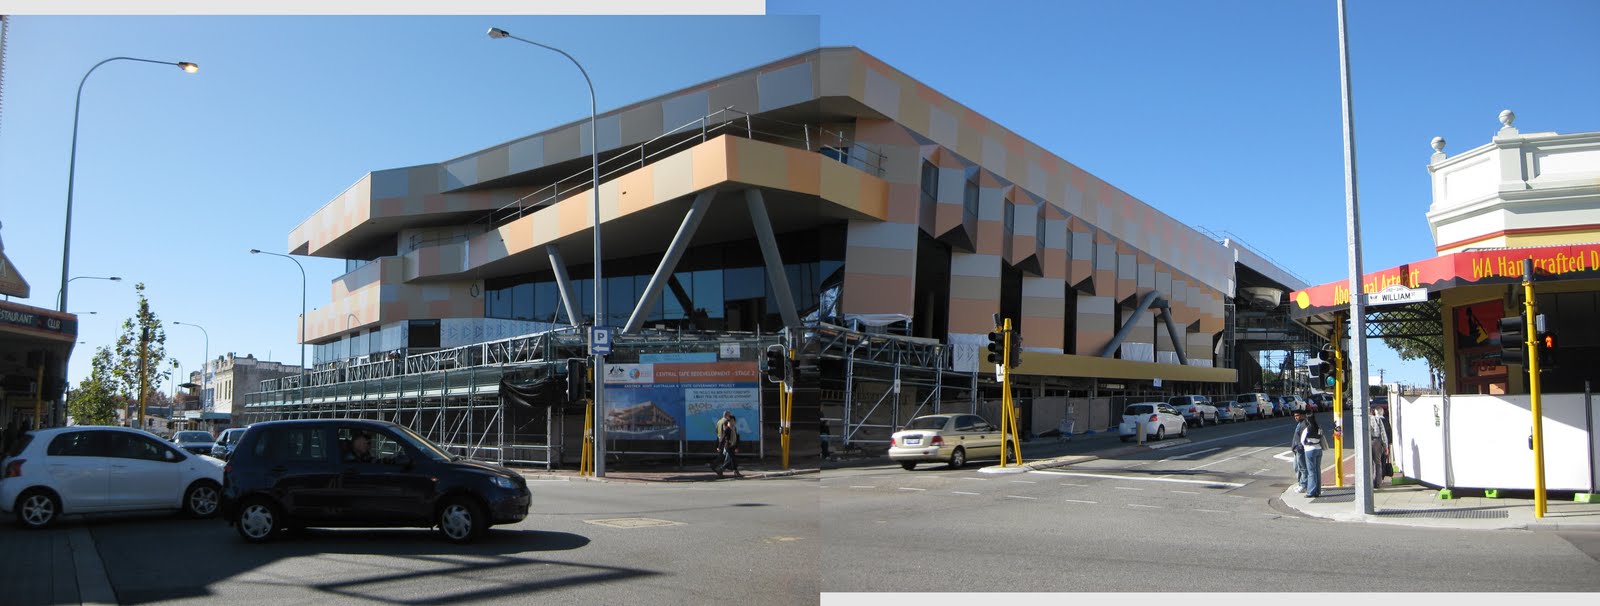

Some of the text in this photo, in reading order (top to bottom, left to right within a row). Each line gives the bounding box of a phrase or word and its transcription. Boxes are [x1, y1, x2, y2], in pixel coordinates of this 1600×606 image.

[1472, 257, 1493, 278] WA
[1497, 251, 1585, 277] Hancrafted
[1333, 276, 1378, 306] Abonal
[1381, 292, 1411, 302] WILLIAM
[0, 309, 33, 325] STAURANT
[597, 332, 605, 341] P
